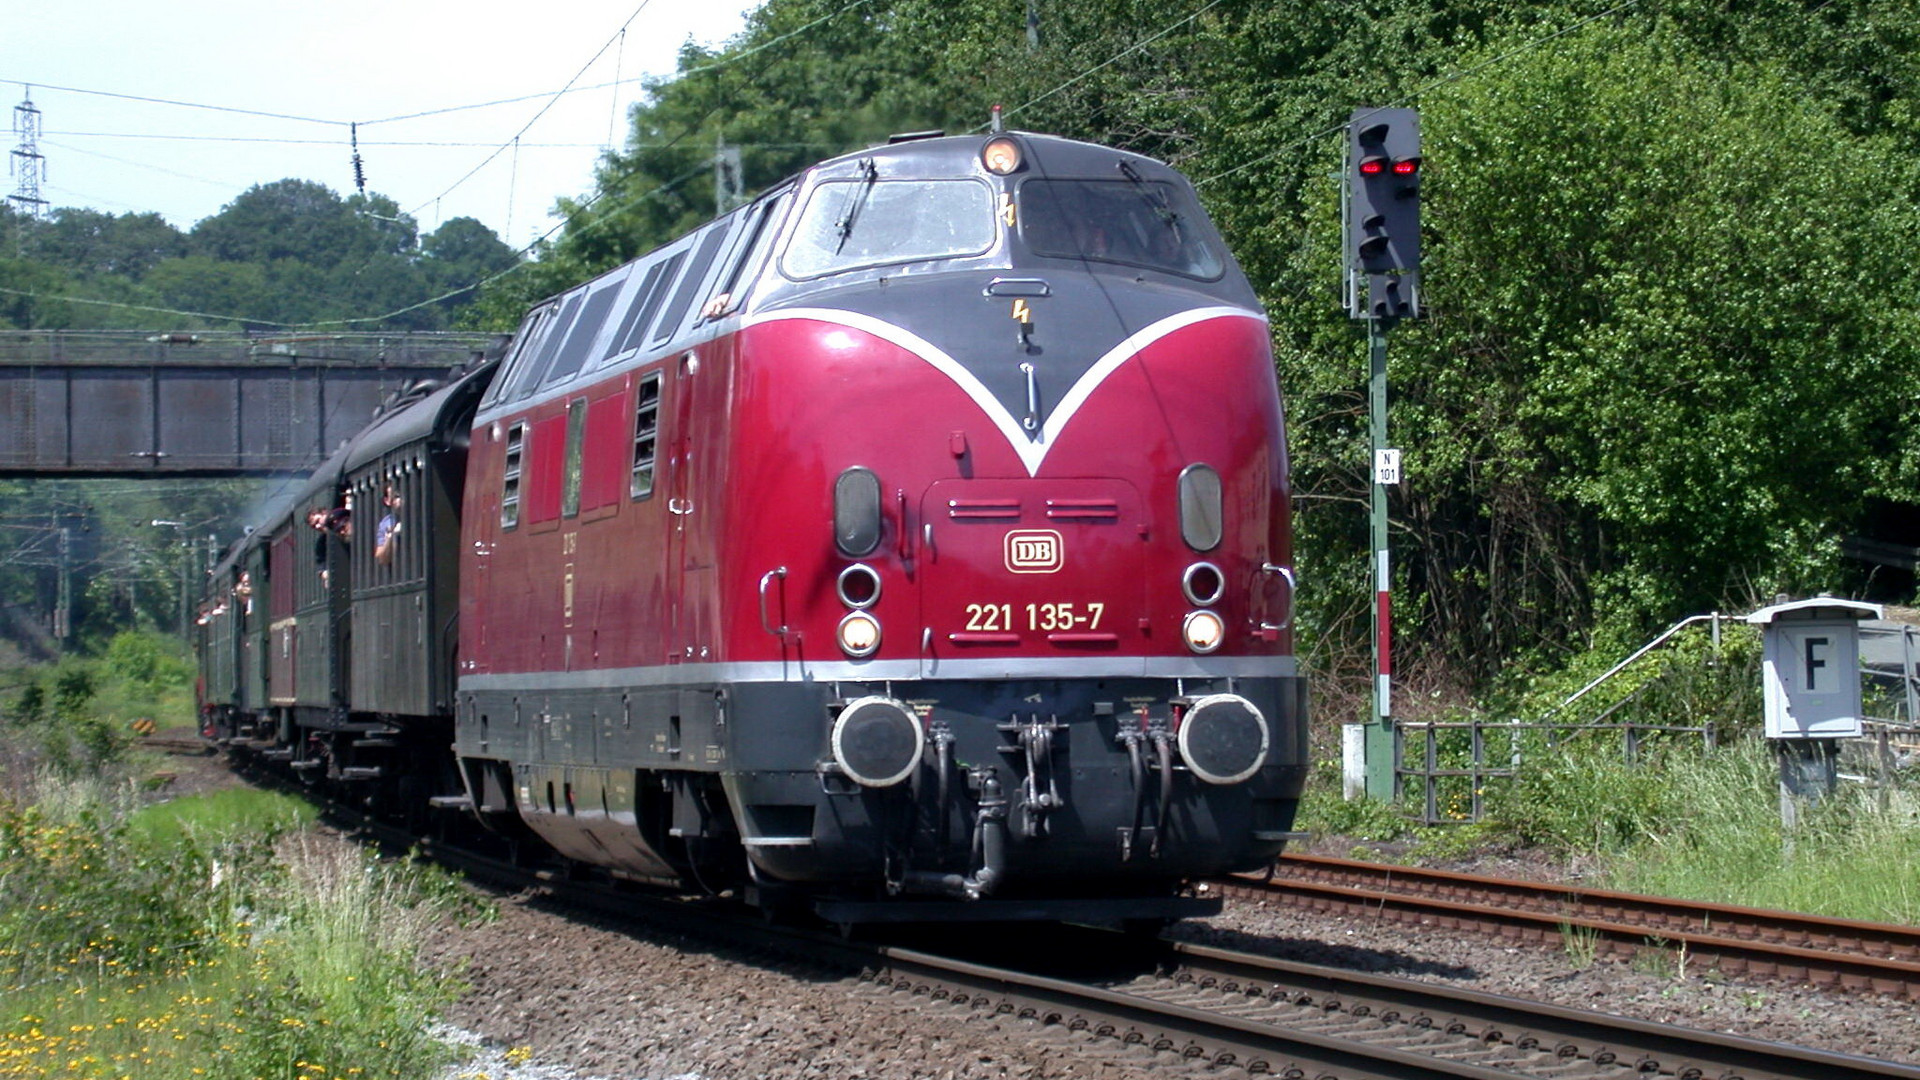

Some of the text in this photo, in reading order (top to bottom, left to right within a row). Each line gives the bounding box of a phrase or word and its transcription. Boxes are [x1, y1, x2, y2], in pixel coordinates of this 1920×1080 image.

[1383, 453, 1391, 465] N
[1380, 468, 1396, 481] 101
[1016, 542, 1051, 561] DB
[965, 602, 1104, 631] 221 135-7
[1804, 637, 1829, 691] F
